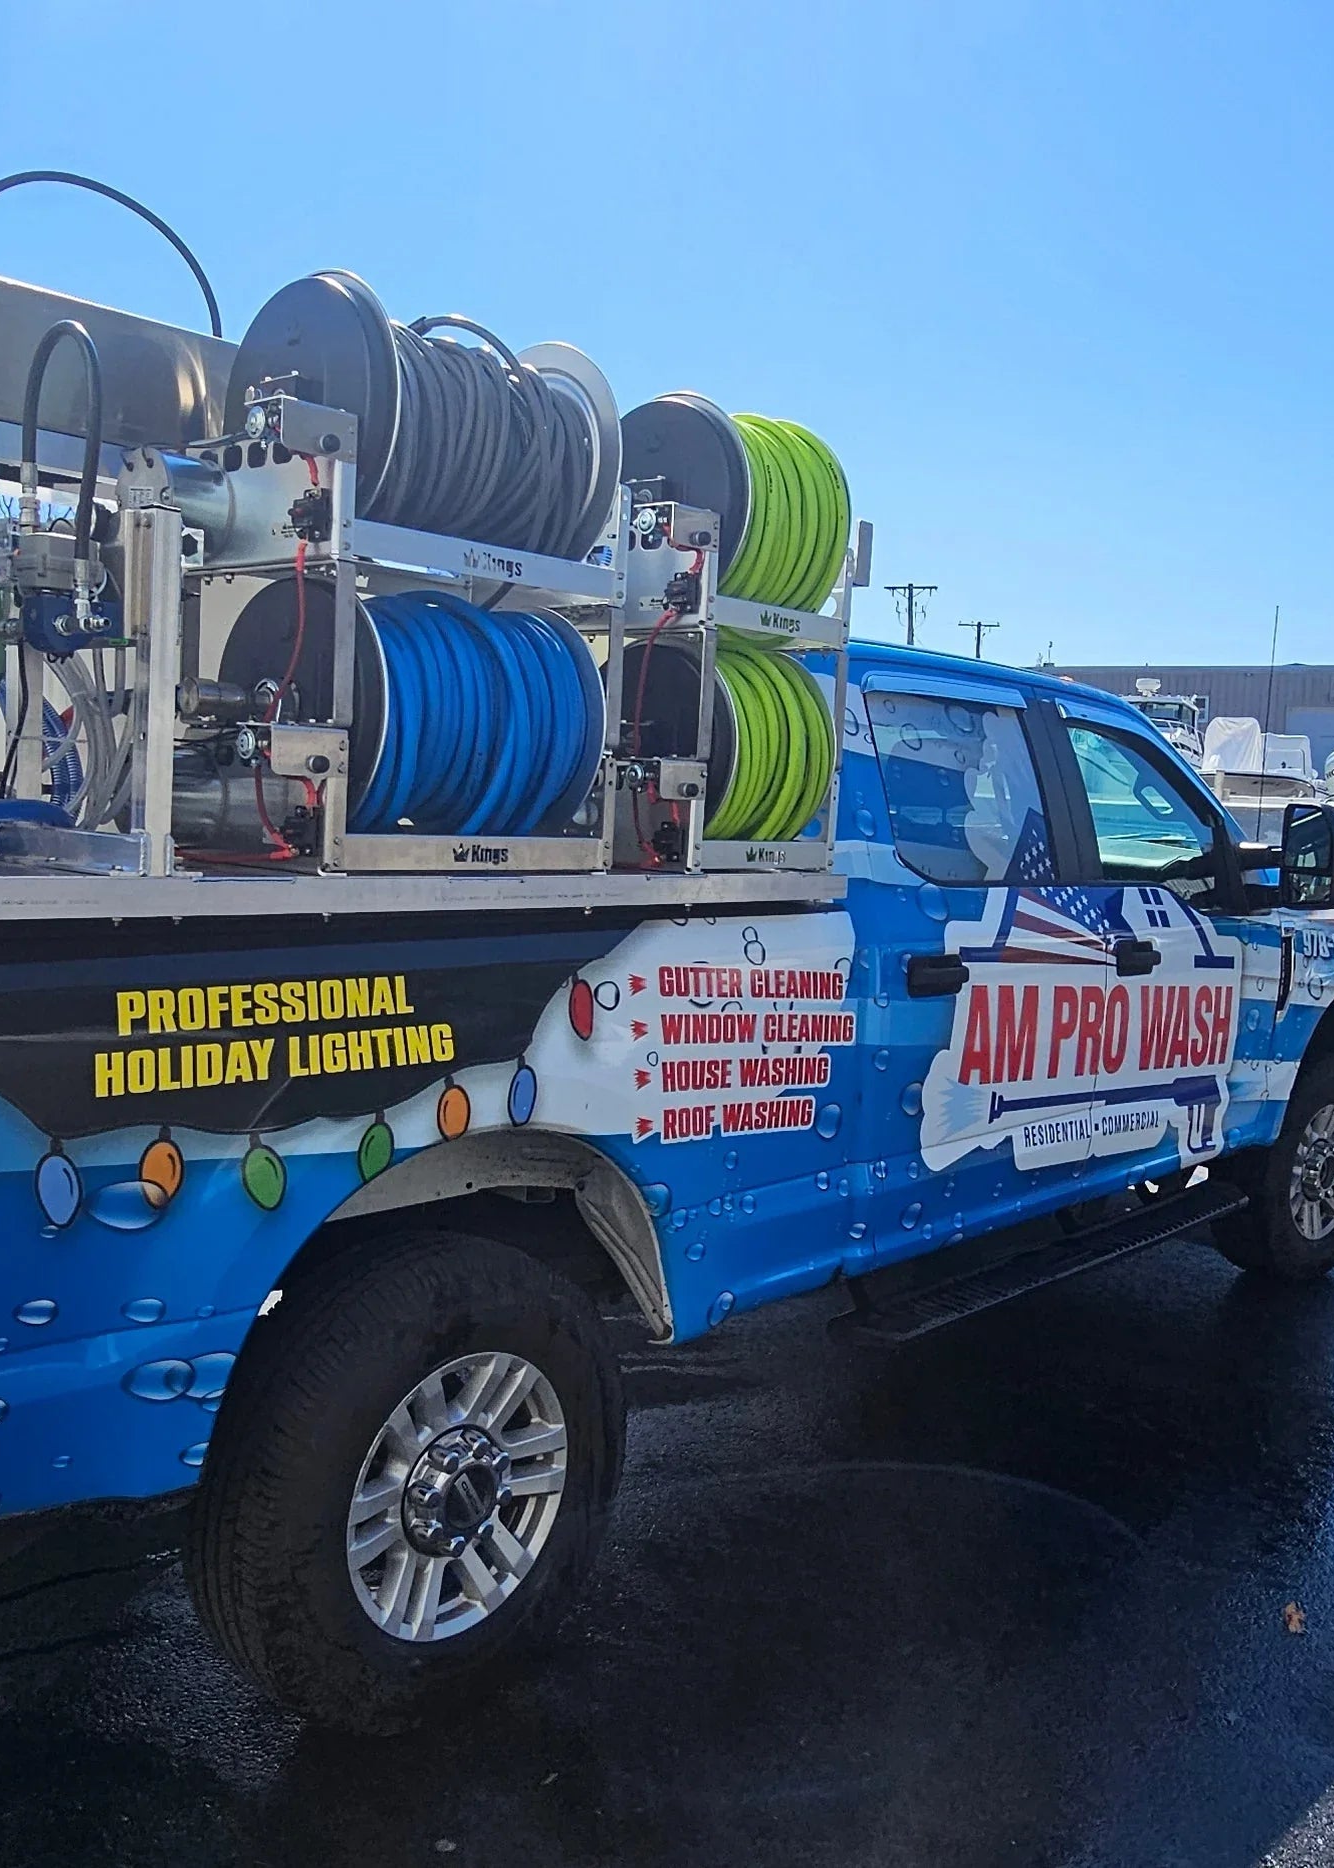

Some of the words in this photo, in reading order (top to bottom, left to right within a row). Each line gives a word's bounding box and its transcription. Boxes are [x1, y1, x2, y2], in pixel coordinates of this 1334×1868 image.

[772, 612, 801, 633] Kings
[471, 844, 509, 865] Kings
[658, 966, 743, 997] GUTTER
[750, 968, 844, 1000] CLEANING
[117, 975, 414, 1036] PROFESSIONAL
[661, 1014, 757, 1044] WINDOW
[763, 1013, 855, 1043] CLEANING
[958, 985, 1040, 1085] AM
[1047, 985, 1130, 1079] PRO
[1138, 985, 1233, 1071] WASH
[95, 1038, 275, 1098] HOLIDAY
[289, 1023, 455, 1078] LIGHTING
[661, 1059, 732, 1092] HOUSE
[739, 1057, 829, 1087] WASHING
[663, 1105, 716, 1140] ROOF
[722, 1099, 813, 1133] WASHING
[1023, 1118, 1092, 1148] RESIDENTIAL
[1101, 1111, 1159, 1136] COMMERCIAL
